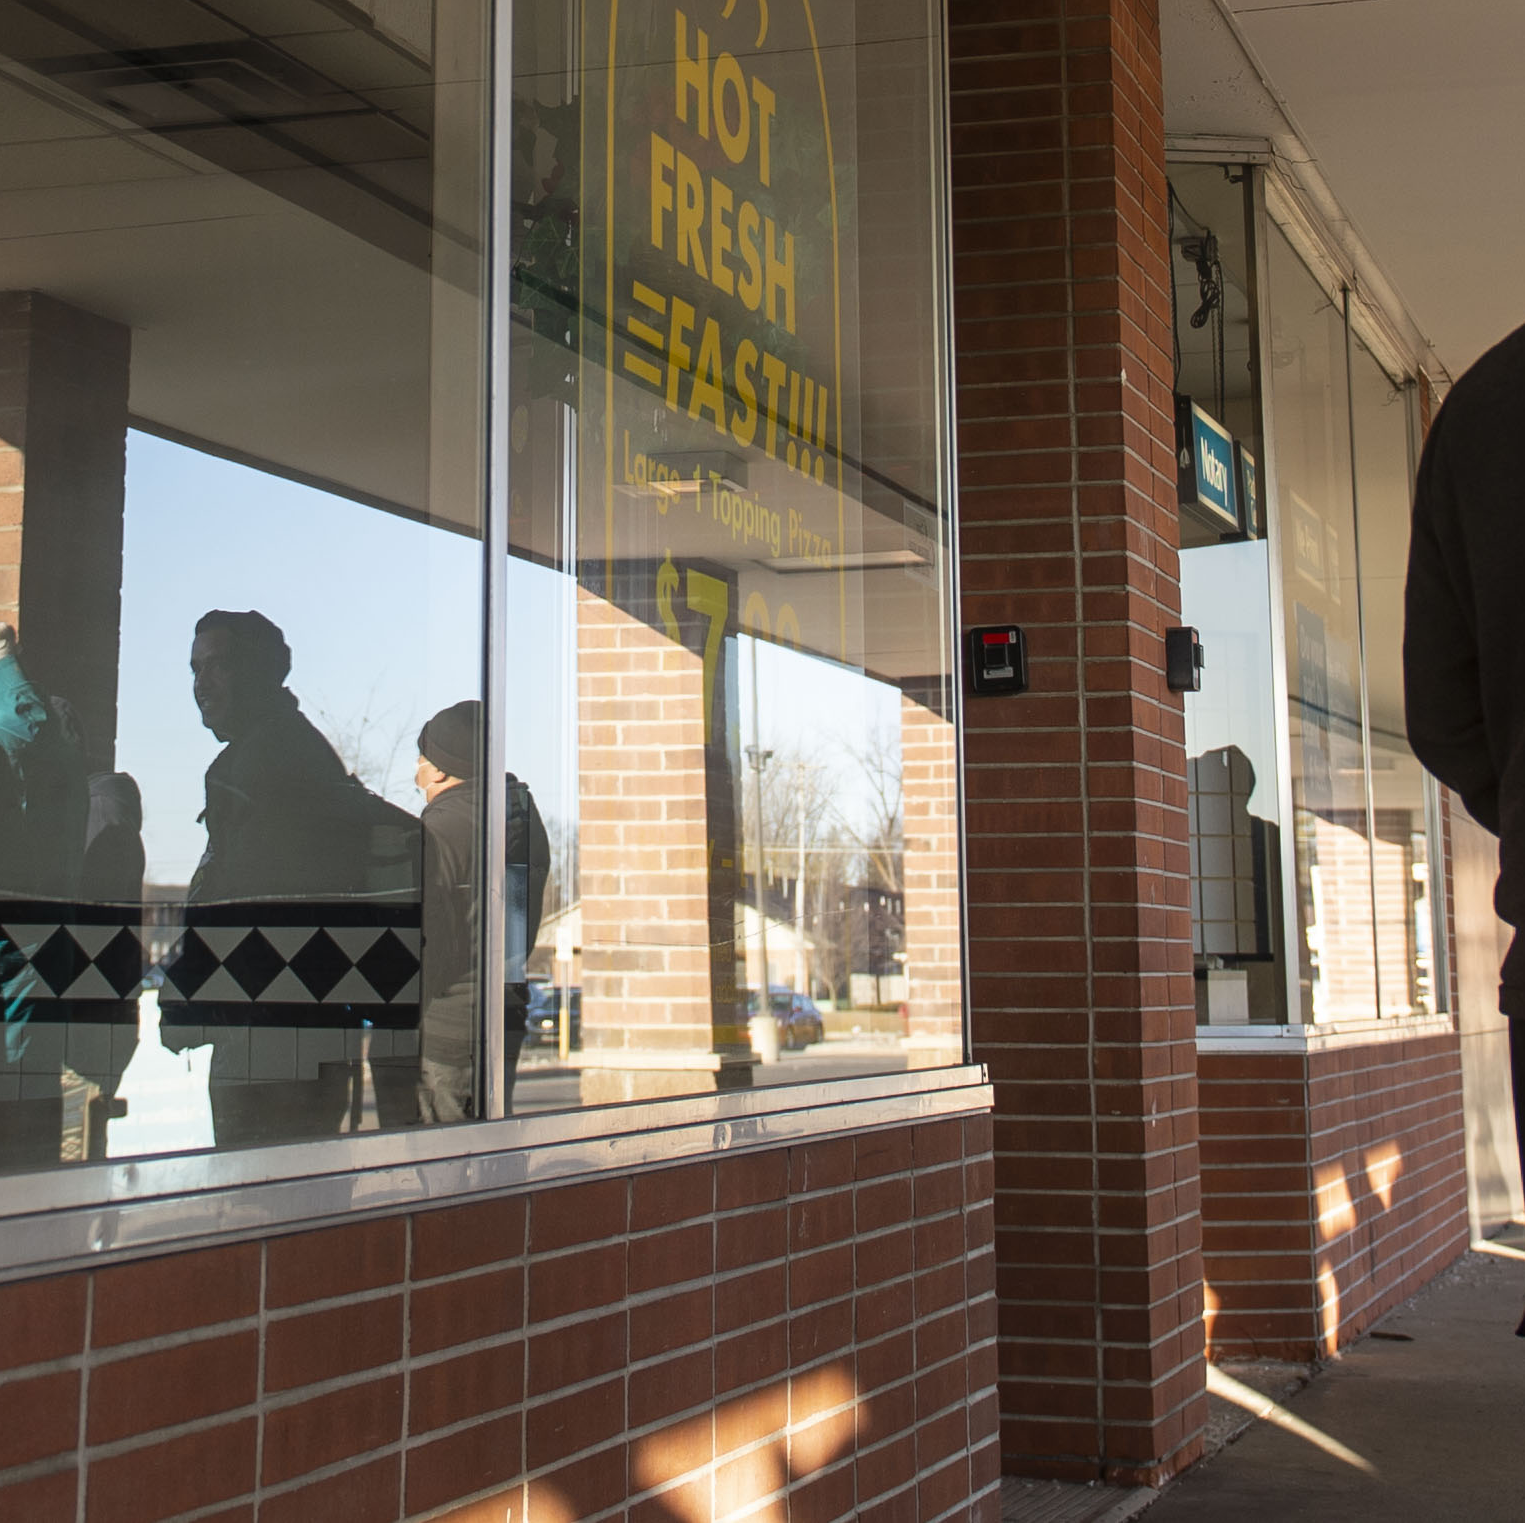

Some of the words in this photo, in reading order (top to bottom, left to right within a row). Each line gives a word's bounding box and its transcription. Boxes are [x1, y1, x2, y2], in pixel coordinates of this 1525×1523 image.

[675, 8, 776, 187] HOT
[649, 131, 797, 336] FRESH
[665, 315, 829, 488] FAST!!!
[1198, 435, 1230, 509] Notary
[623, 428, 681, 515] Large
[692, 462, 703, 514] 1
[708, 468, 782, 559] Topping
[788, 507, 833, 570] Pizza
